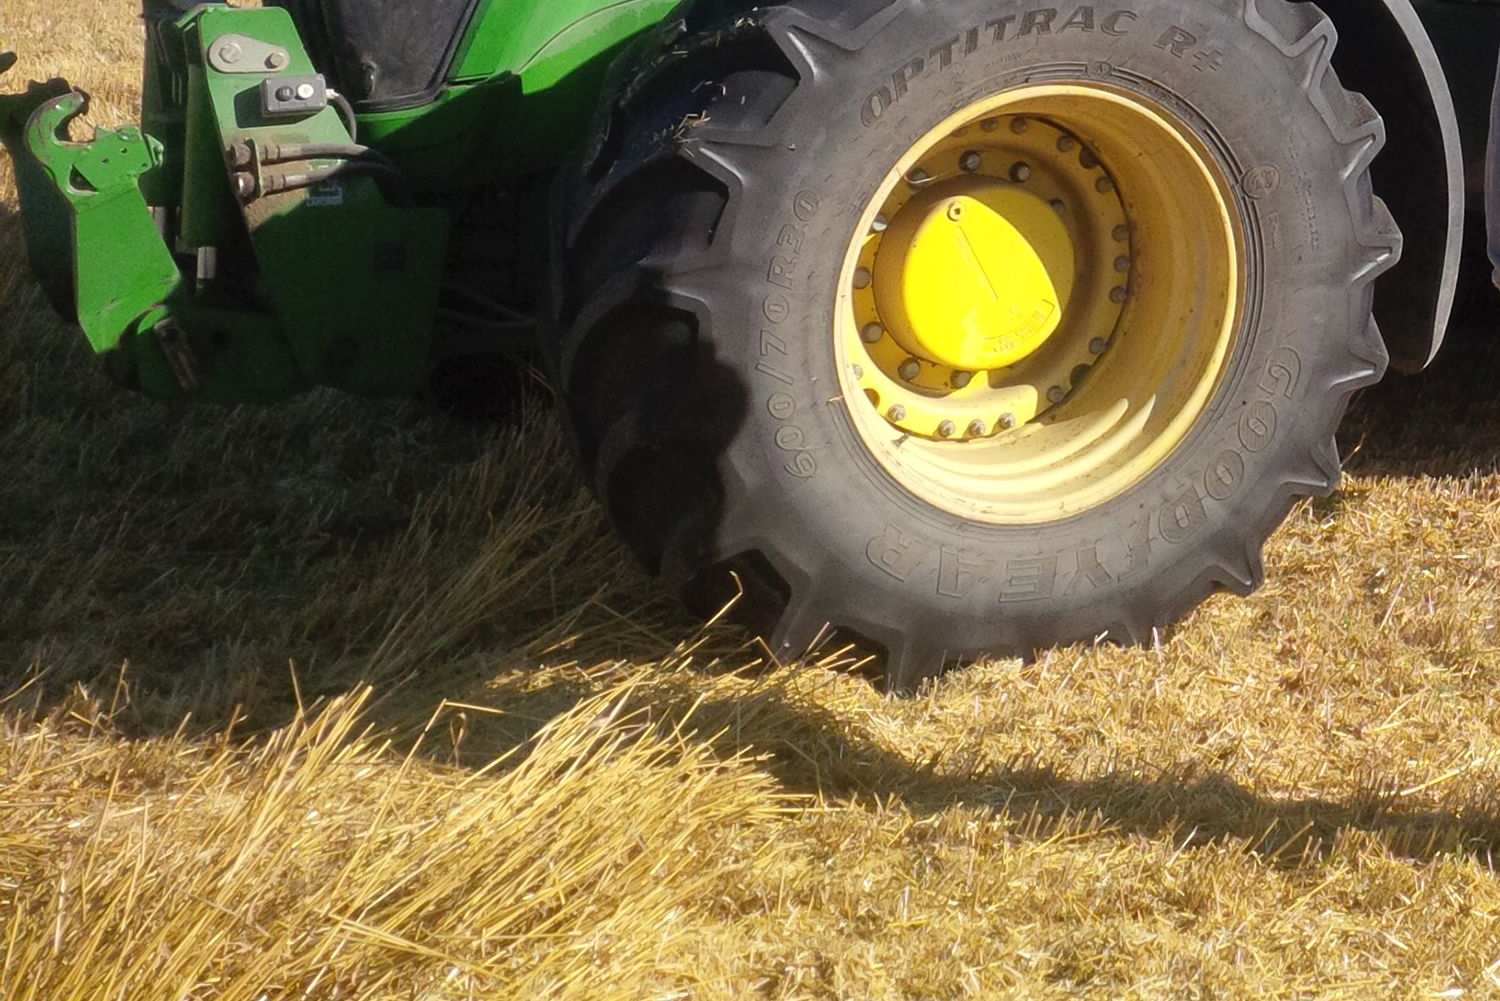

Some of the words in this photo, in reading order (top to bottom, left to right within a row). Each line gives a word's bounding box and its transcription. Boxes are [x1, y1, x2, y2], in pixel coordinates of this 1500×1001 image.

[860, 4, 1139, 128] OPTITRAC
[756, 188, 819, 479] 600/70R30
[865, 346, 1301, 602] GOODYEAR
